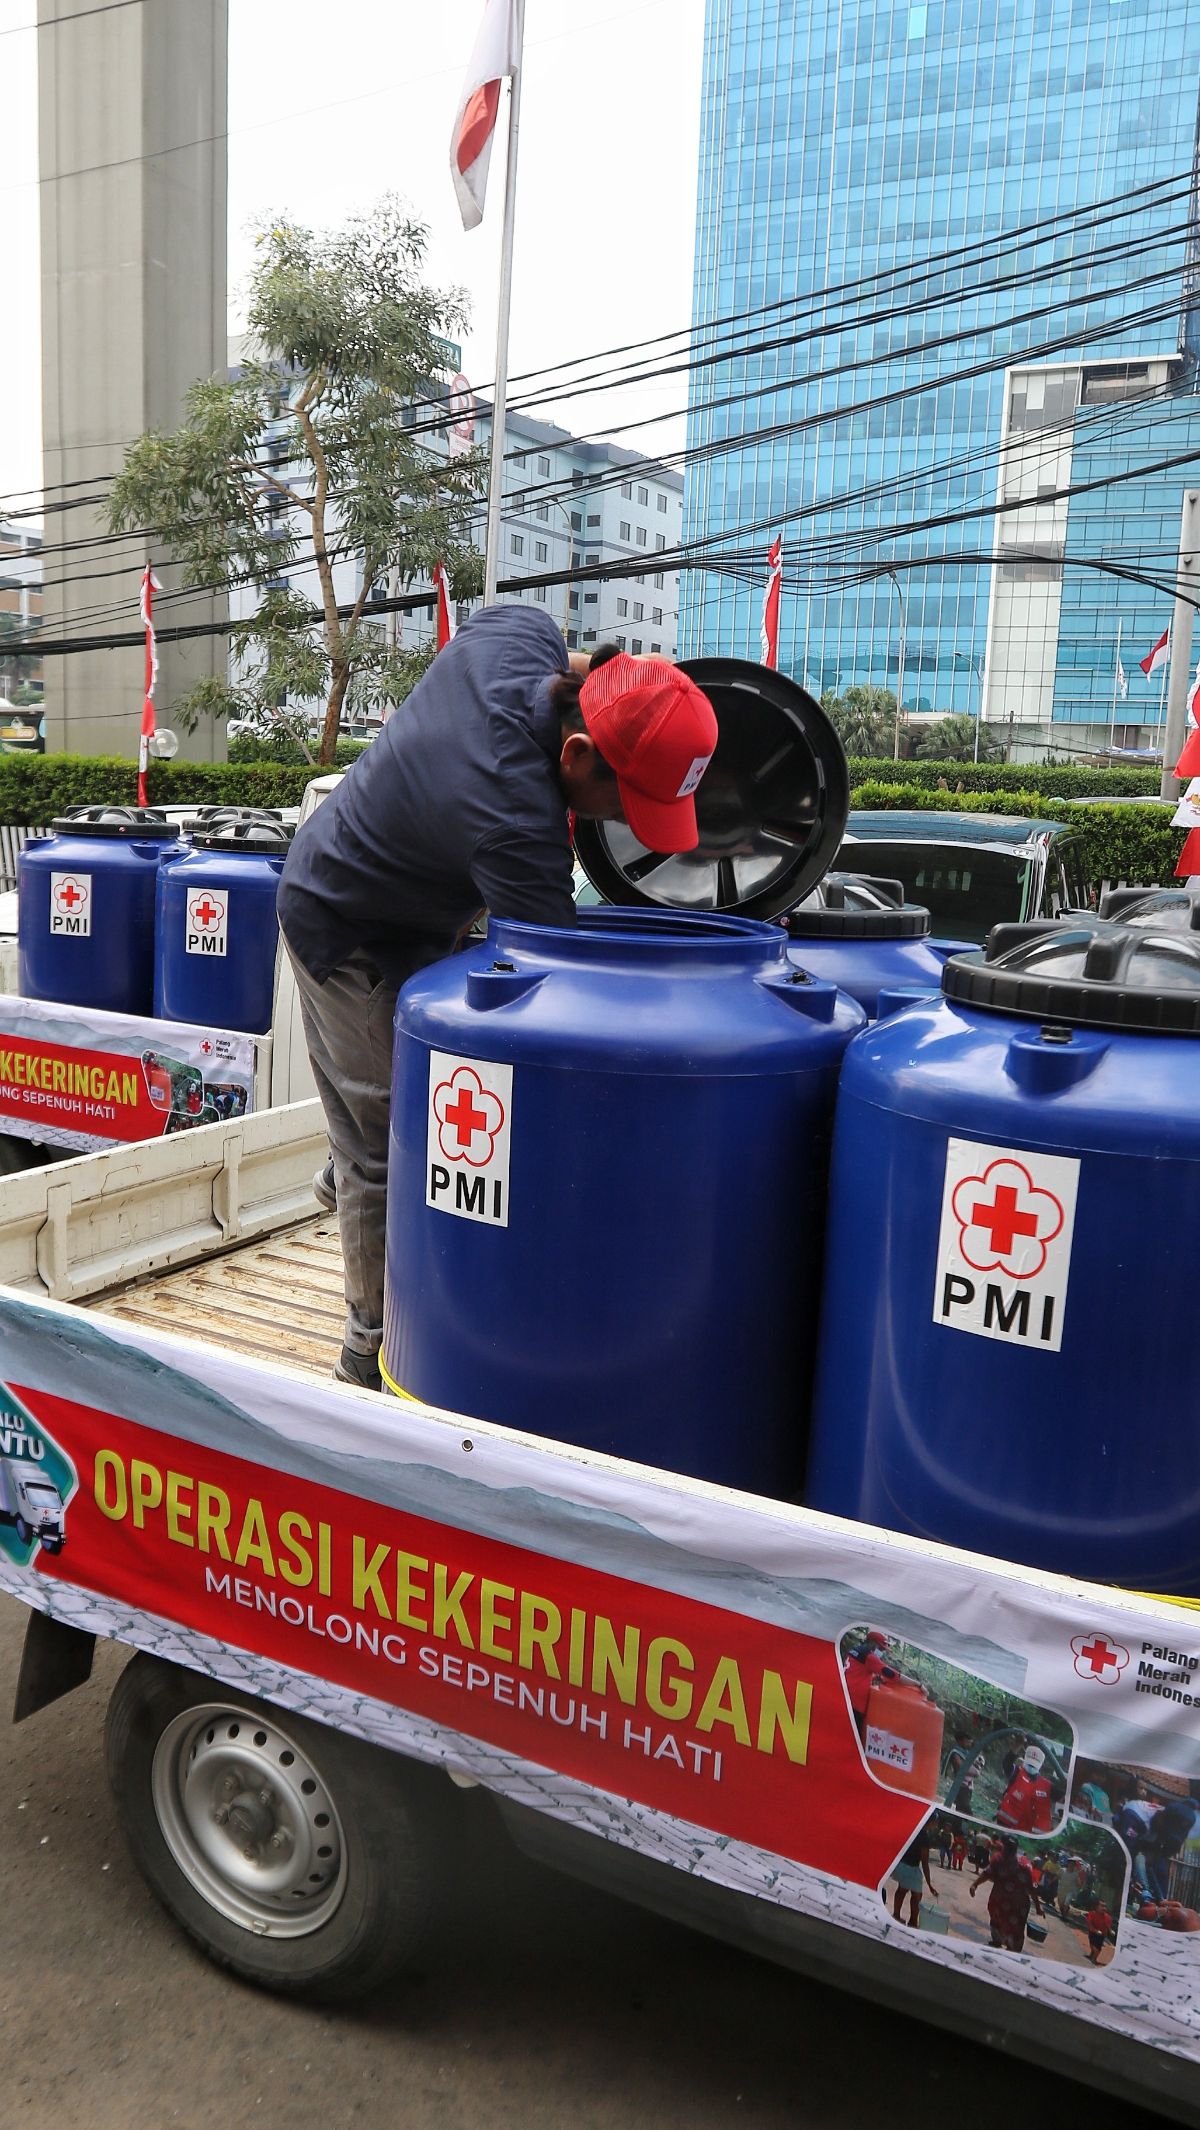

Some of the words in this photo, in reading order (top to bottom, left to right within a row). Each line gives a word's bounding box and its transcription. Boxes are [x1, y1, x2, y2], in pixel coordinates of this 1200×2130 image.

[52, 916, 88, 934] PMI
[188, 934, 224, 953] PMI
[0, 1050, 137, 1107] KEKERINGAN
[0, 1085, 20, 1100] NG
[22, 1089, 82, 1113] SEPENUH
[85, 1102, 115, 1120] HATI
[430, 1163, 502, 1218] PMI
[942, 1272, 1056, 1341] PMI
[93, 1448, 333, 1598] OPERASI
[352, 1534, 814, 1767] KEKERINGAN
[1141, 1642, 1199, 1670] Palang
[204, 1566, 408, 1666] MENOLONG
[418, 1645, 608, 1741] SEPENUH
[622, 1719, 723, 1783] HATI
[1137, 1660, 1191, 1685] Merah
[1135, 1680, 1200, 1708] Indones
[868, 1744, 885, 1757] PMI
